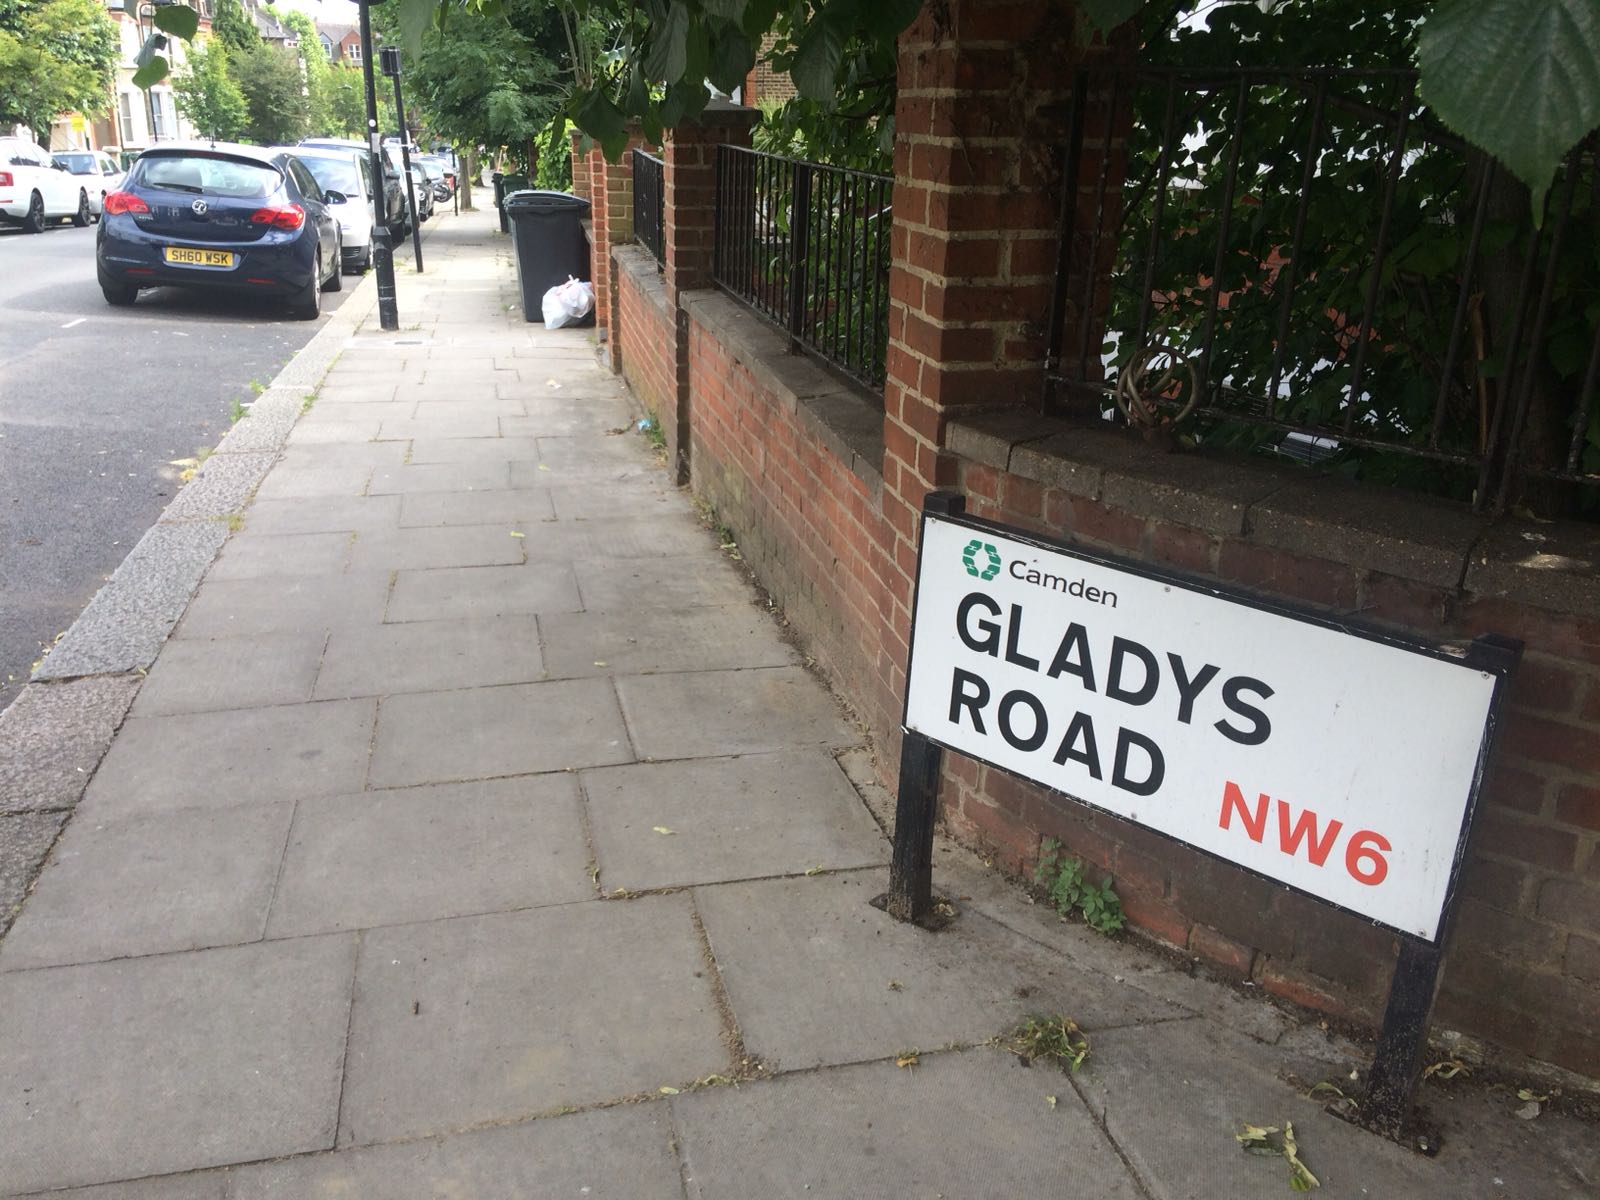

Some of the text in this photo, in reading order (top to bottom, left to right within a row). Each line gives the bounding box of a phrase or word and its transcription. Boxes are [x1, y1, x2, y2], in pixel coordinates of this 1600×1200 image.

[171, 249, 229, 264] SH60 WSK
[1008, 559, 1118, 608] Camden
[956, 592, 1275, 746] GLADYS
[948, 666, 1166, 797] ROAD
[1218, 780, 1393, 887] NW6
